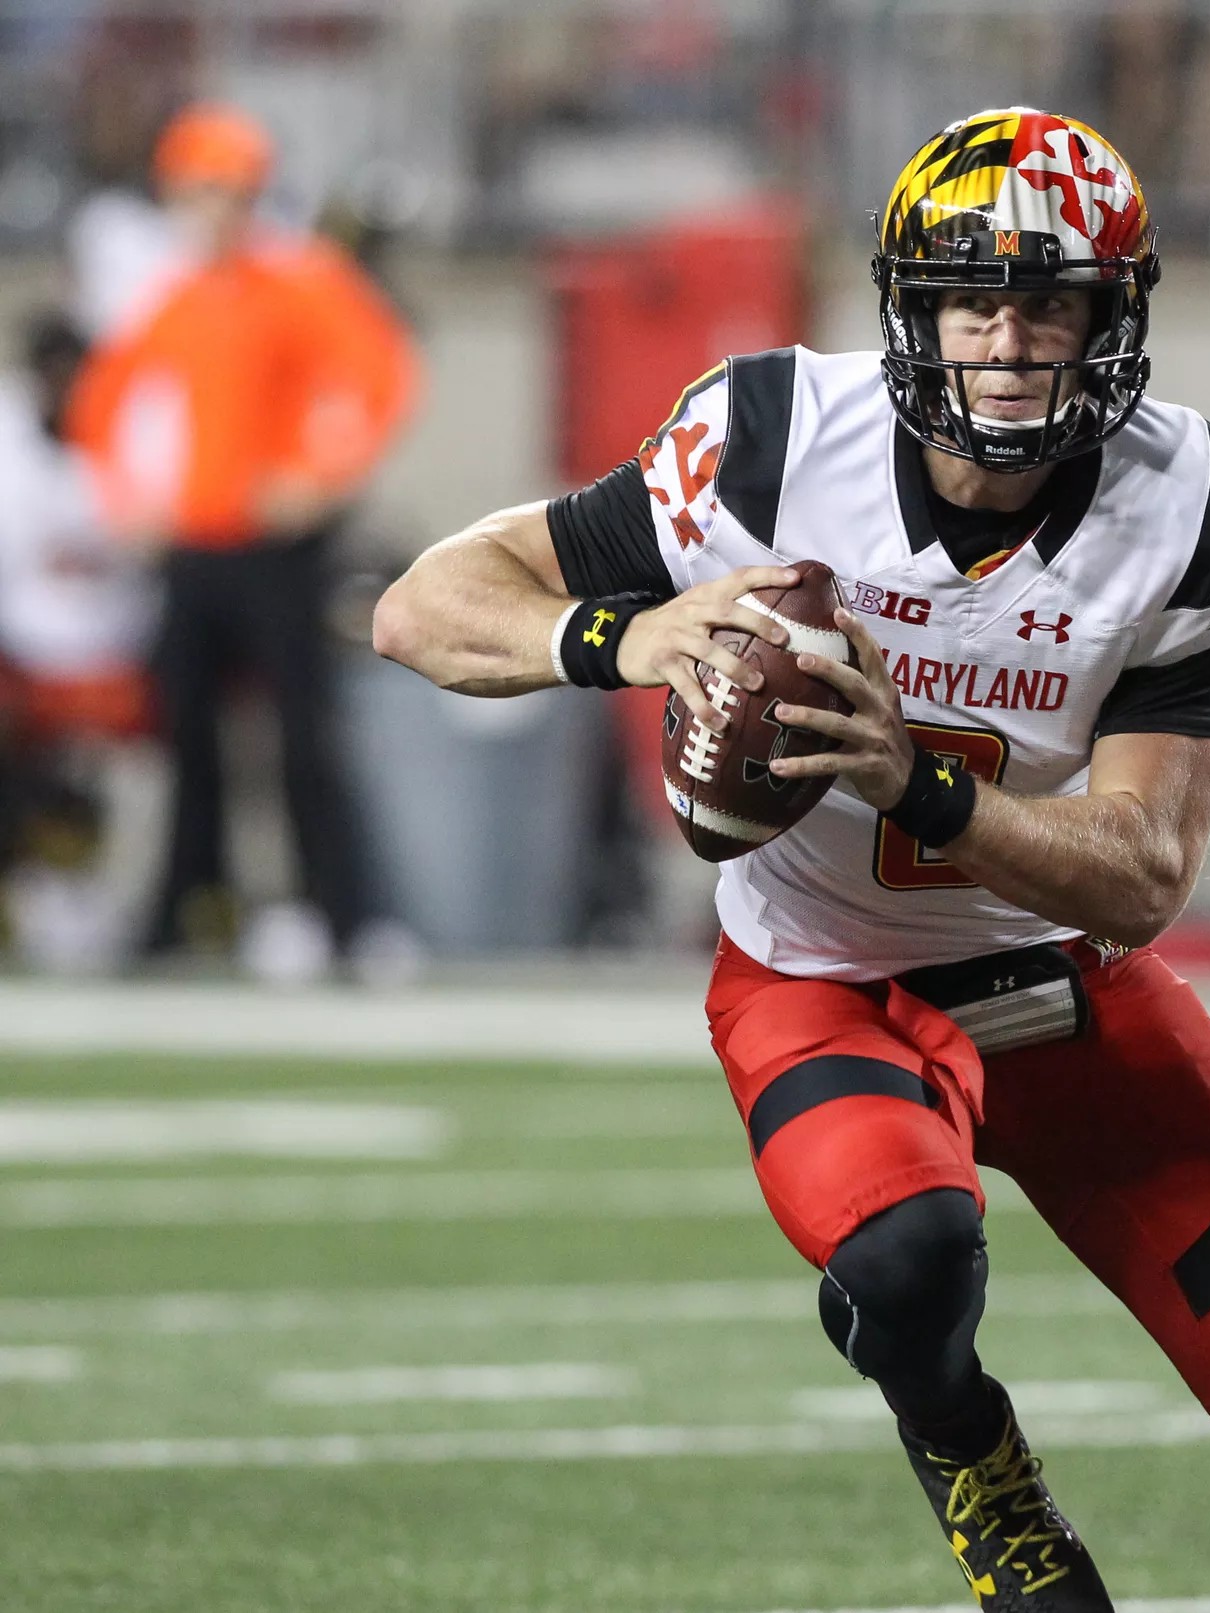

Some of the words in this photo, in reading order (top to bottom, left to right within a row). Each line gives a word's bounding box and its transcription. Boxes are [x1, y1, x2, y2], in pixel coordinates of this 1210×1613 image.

[995, 231, 1020, 255] M
[985, 445, 1024, 455] Riddell
[881, 648, 1069, 712] ARYLAND
